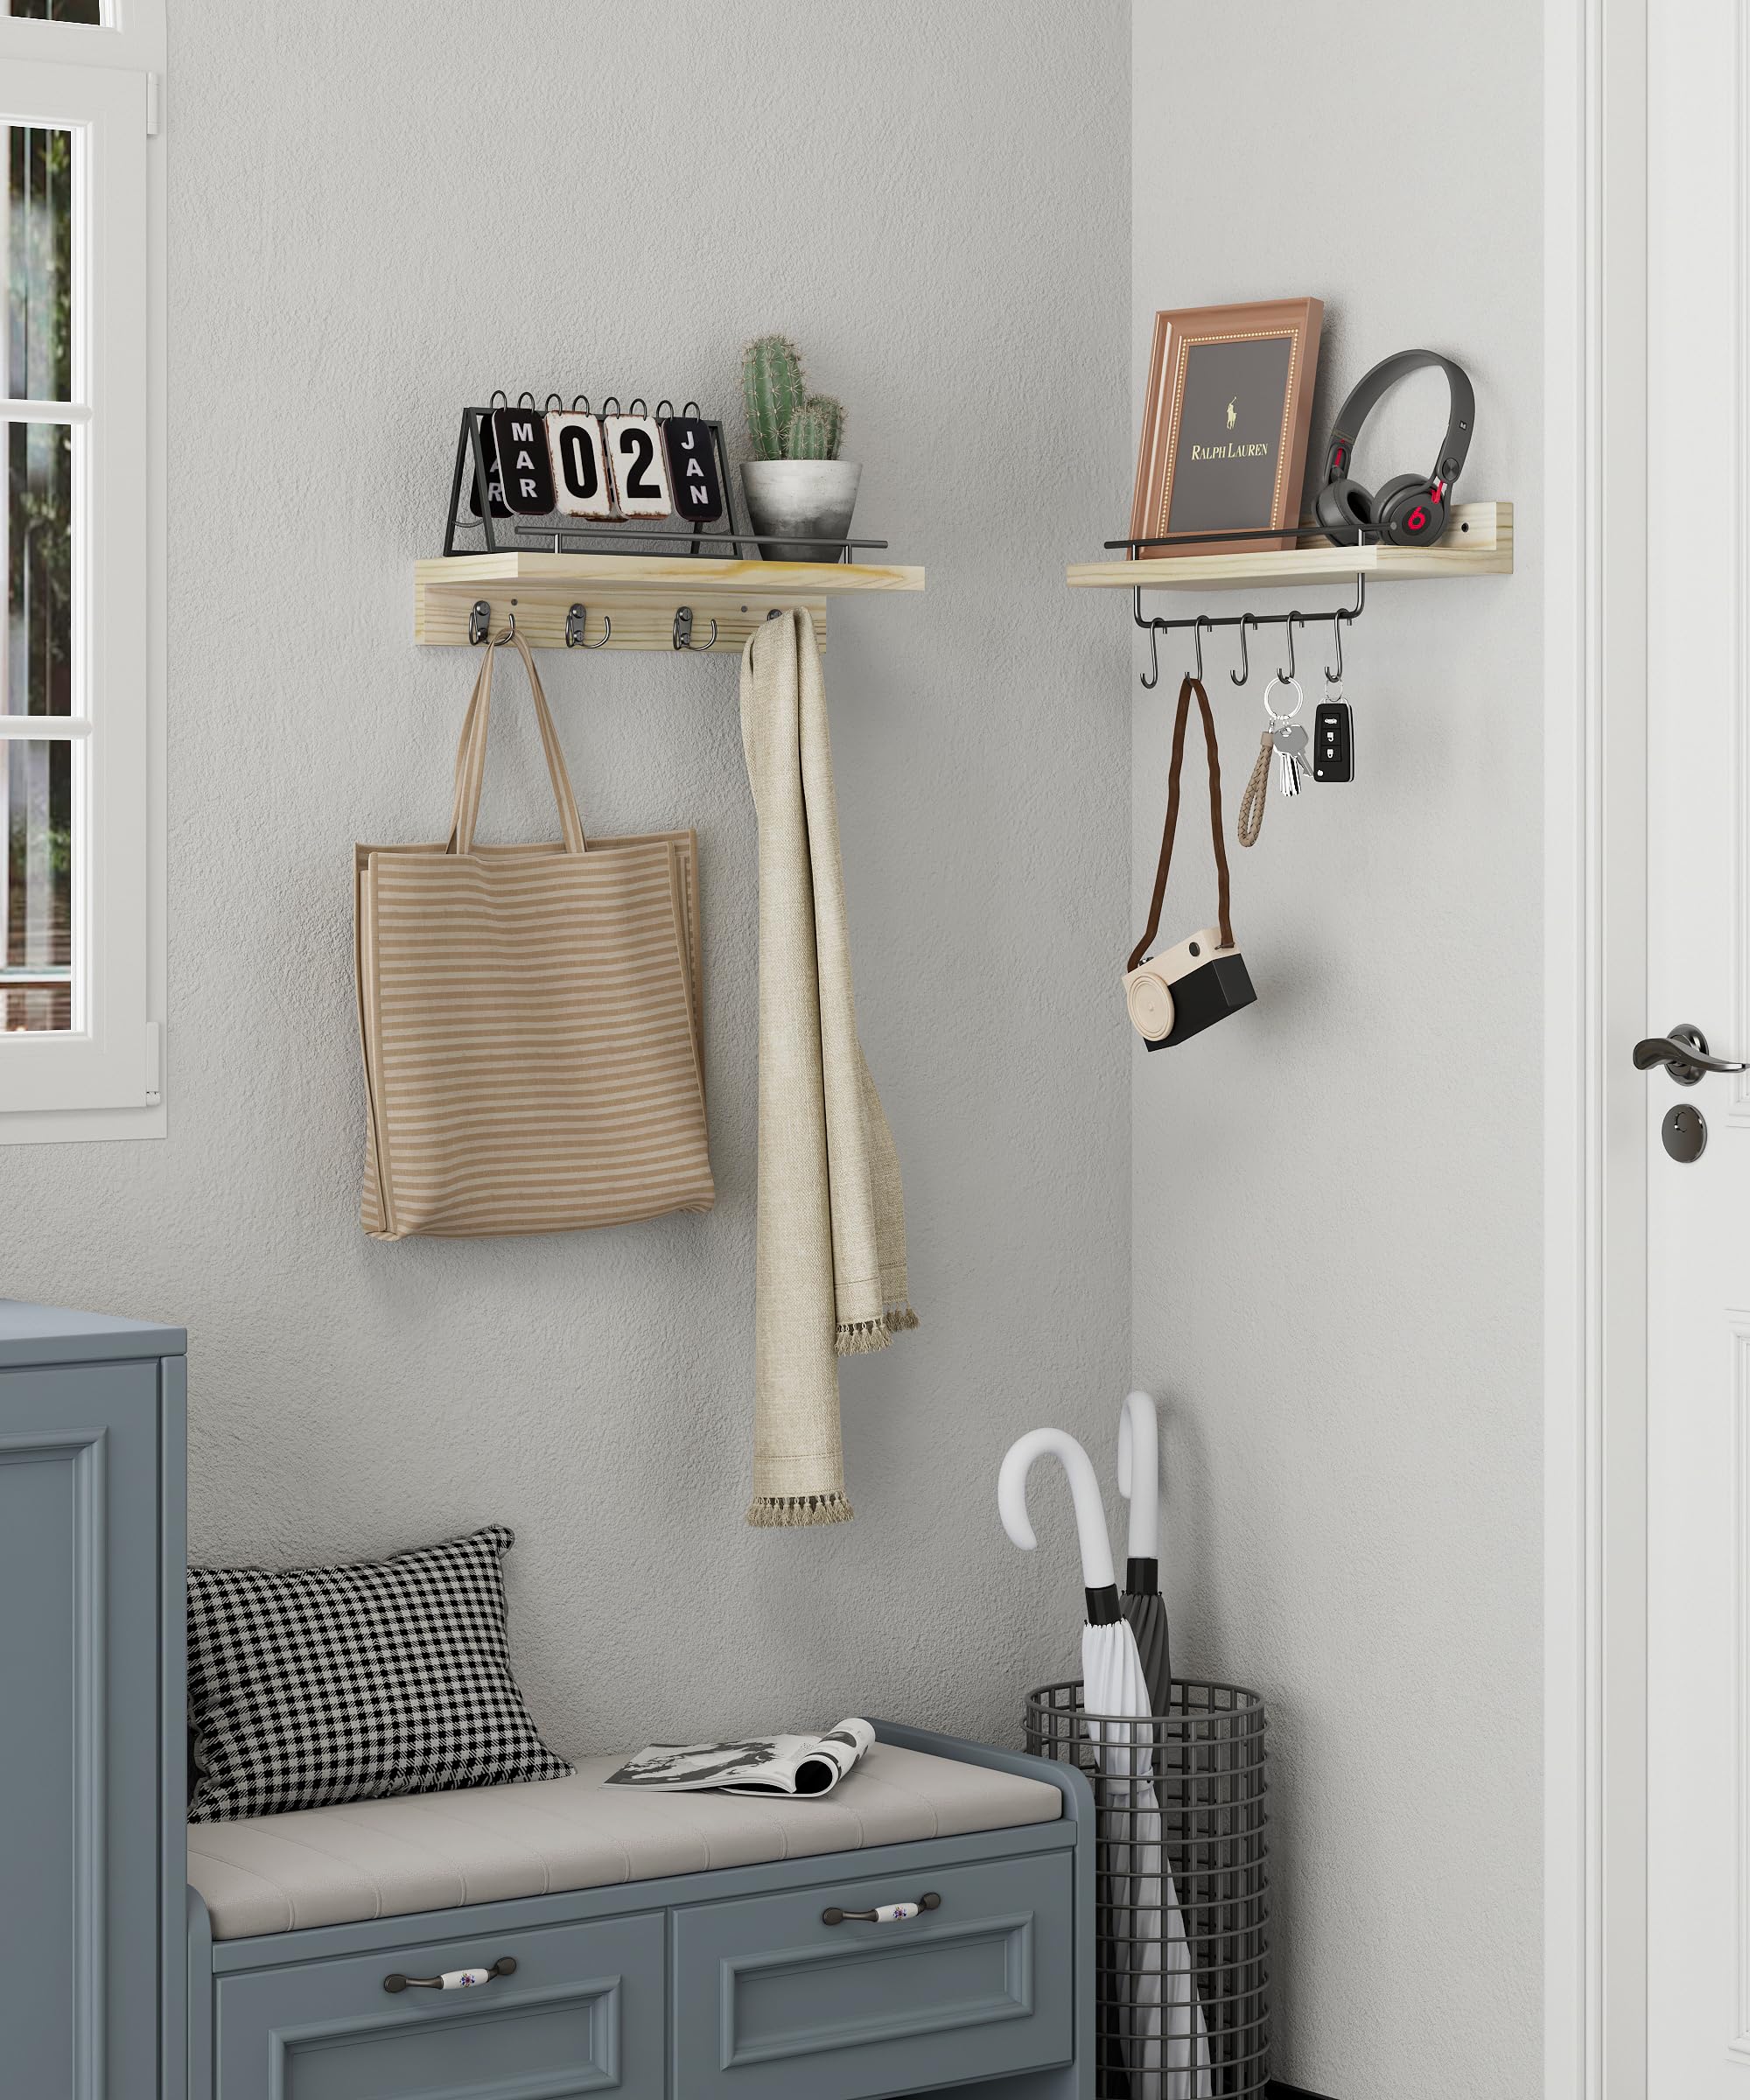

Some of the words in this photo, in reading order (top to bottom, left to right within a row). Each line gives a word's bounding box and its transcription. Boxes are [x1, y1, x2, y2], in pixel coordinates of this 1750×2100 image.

[511, 422, 538, 498] MAR
[680, 430, 709, 505] JAN
[1191, 444, 1226, 460] RALPH
[1228, 442, 1269, 458] LAUREN
